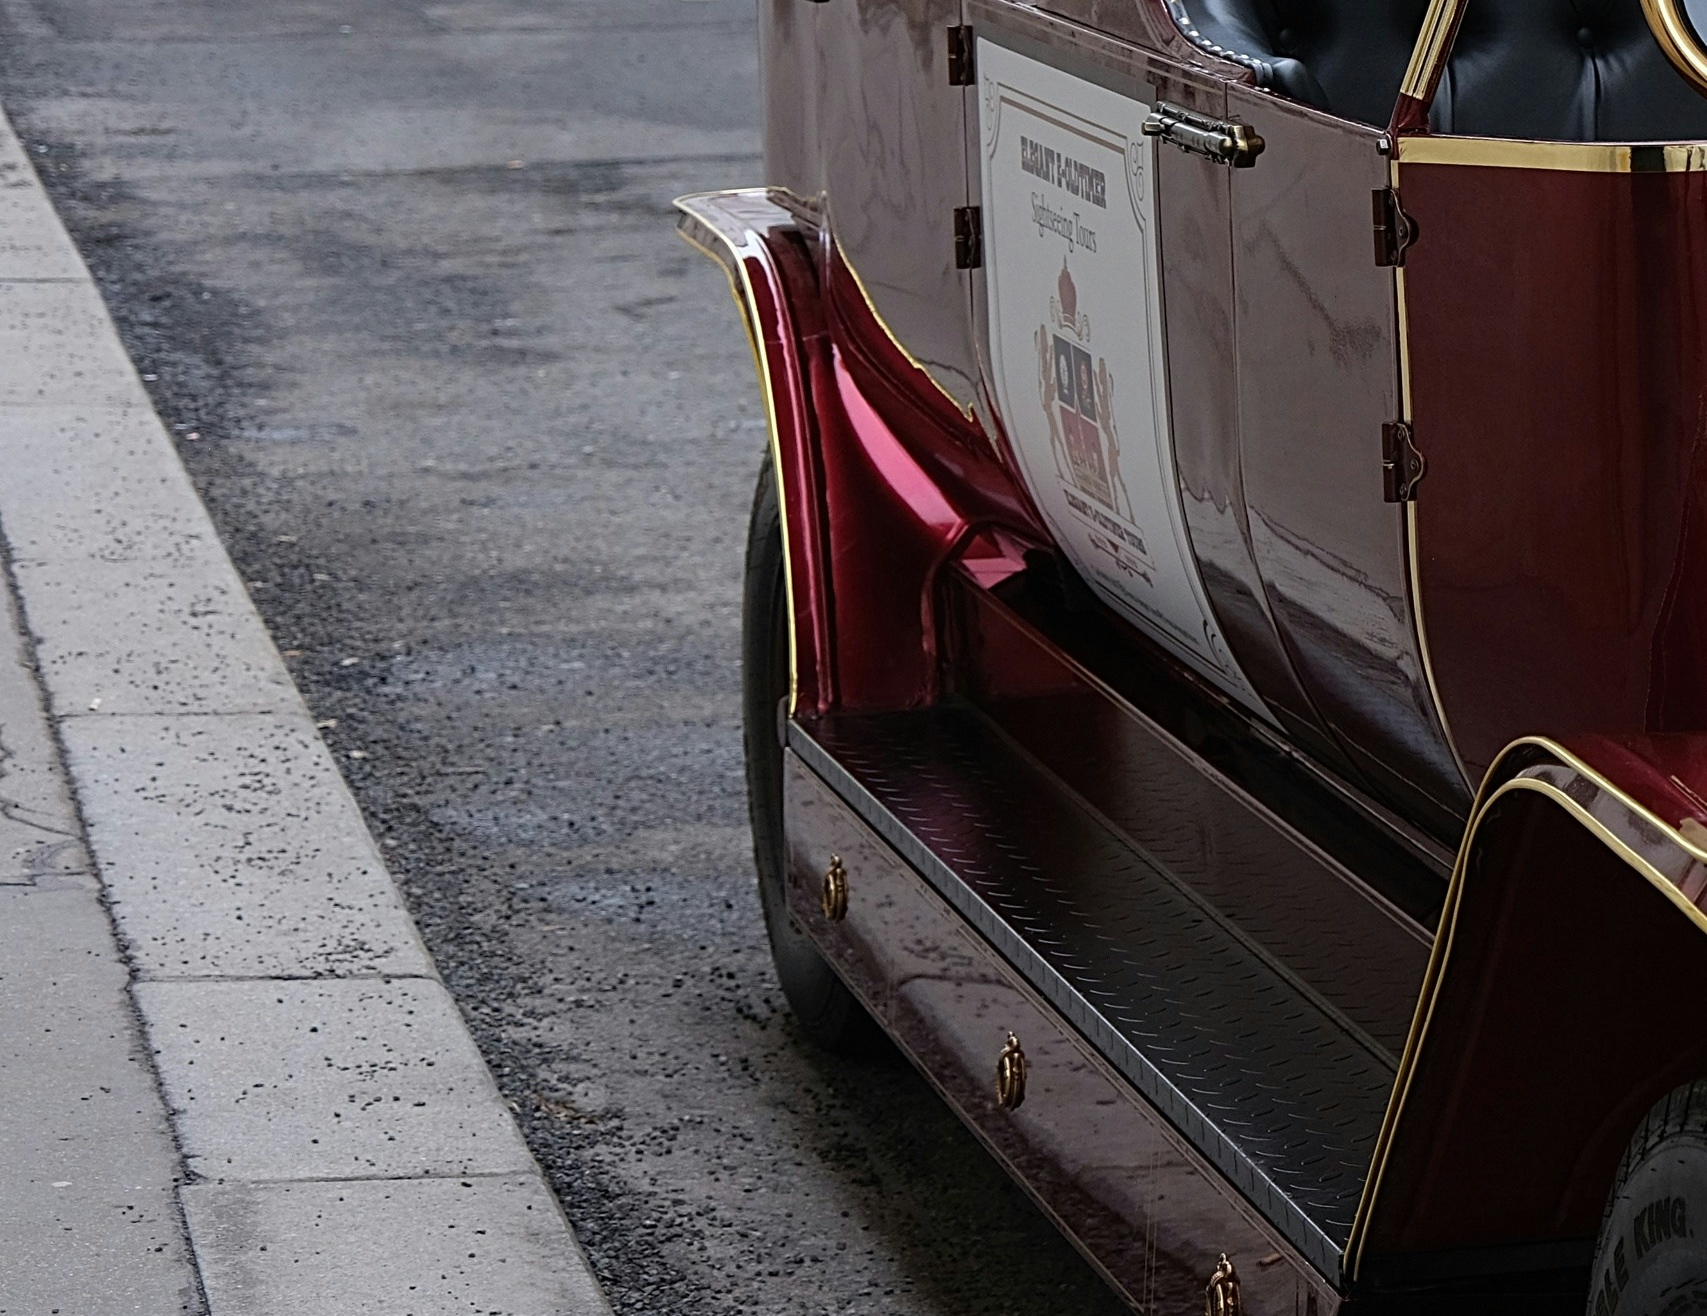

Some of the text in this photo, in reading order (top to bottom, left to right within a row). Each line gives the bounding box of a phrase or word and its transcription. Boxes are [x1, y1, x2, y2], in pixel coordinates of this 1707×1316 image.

[1031, 191, 1097, 254] Sightseeing Tours
[1633, 1195, 1687, 1261] KING
